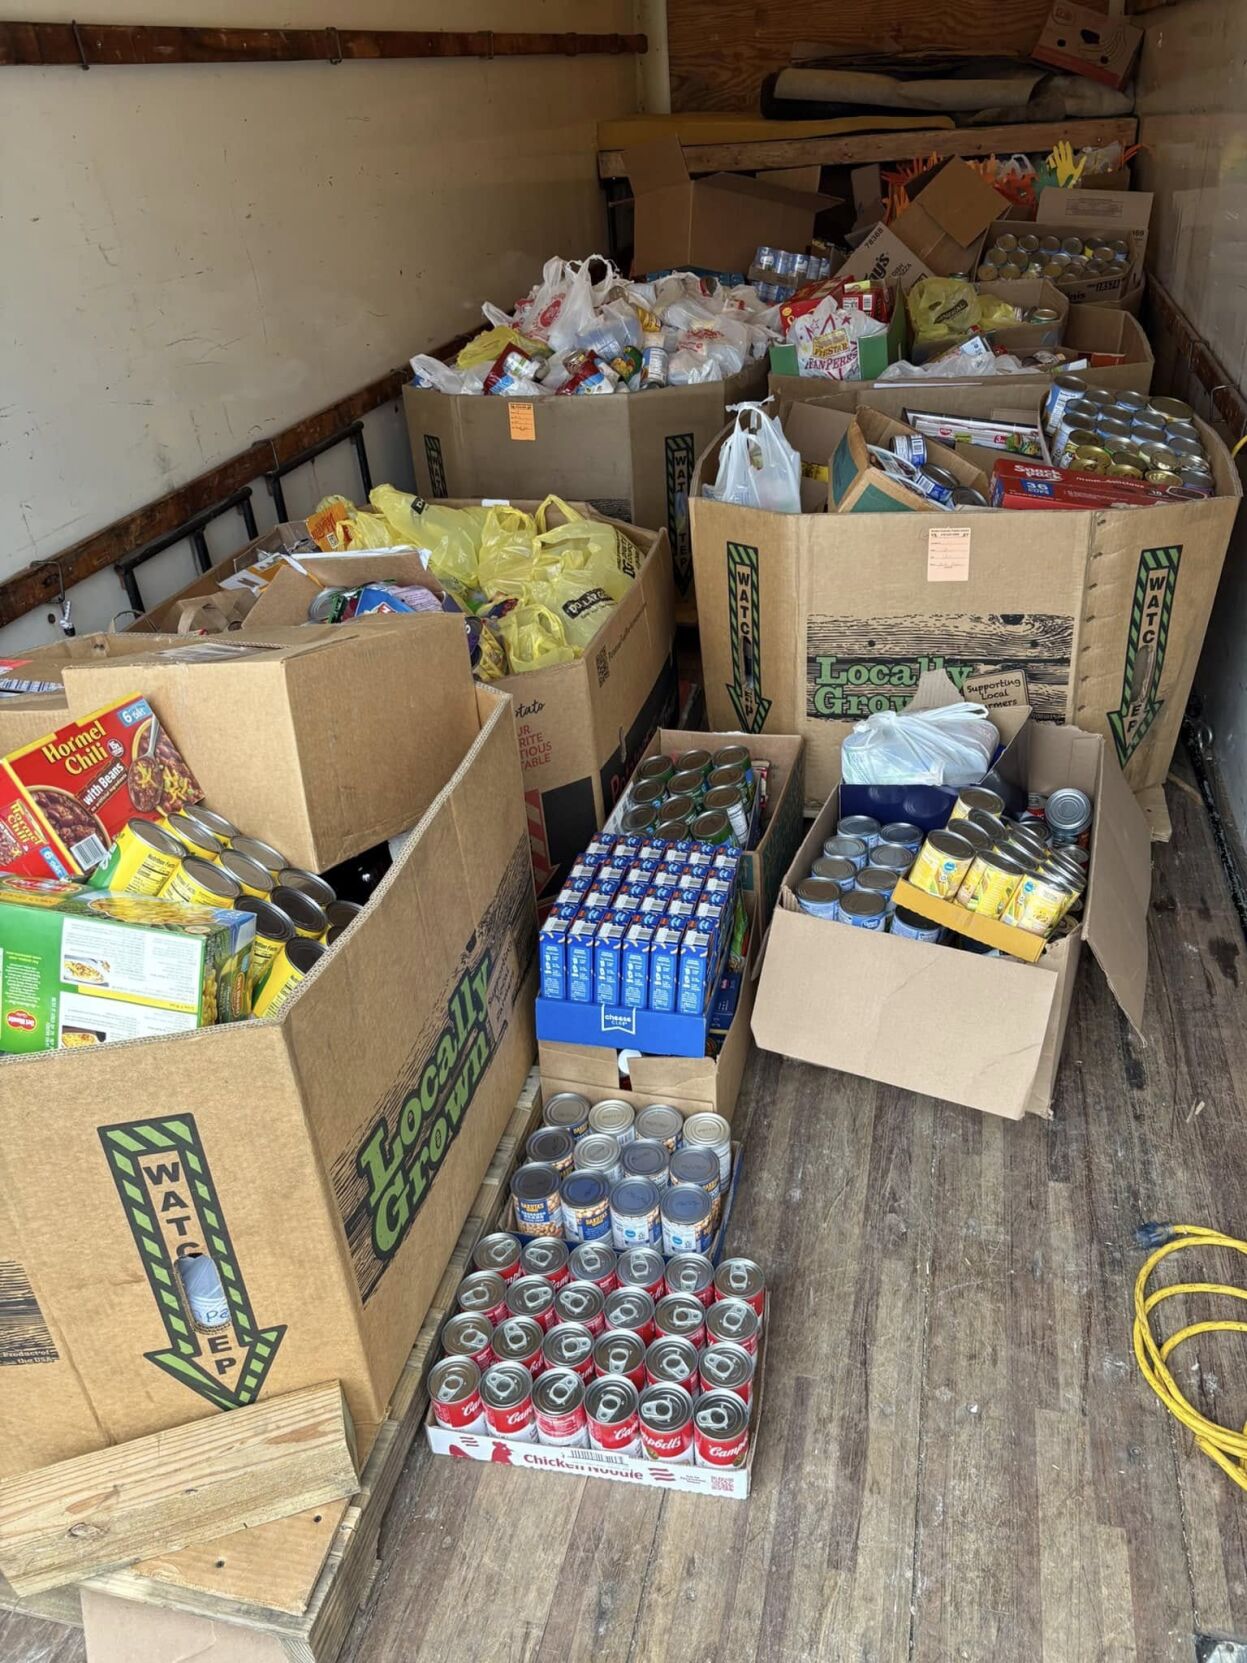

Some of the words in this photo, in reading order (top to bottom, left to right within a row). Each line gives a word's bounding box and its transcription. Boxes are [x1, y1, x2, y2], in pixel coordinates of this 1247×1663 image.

[1141, 575, 1166, 644] WATC
[966, 677, 1021, 695] Supporting
[981, 688, 1009, 700] Local
[122, 711, 132, 724] 6
[42, 720, 107, 764] Hormel
[64, 742, 109, 776] Chili
[83, 784, 103, 806] with
[99, 762, 125, 789] Beans
[356, 953, 492, 1210] Locally
[372, 1027, 492, 1258] Grown
[142, 1161, 201, 1258] WATC
[2, 1349, 41, 1358] Product
